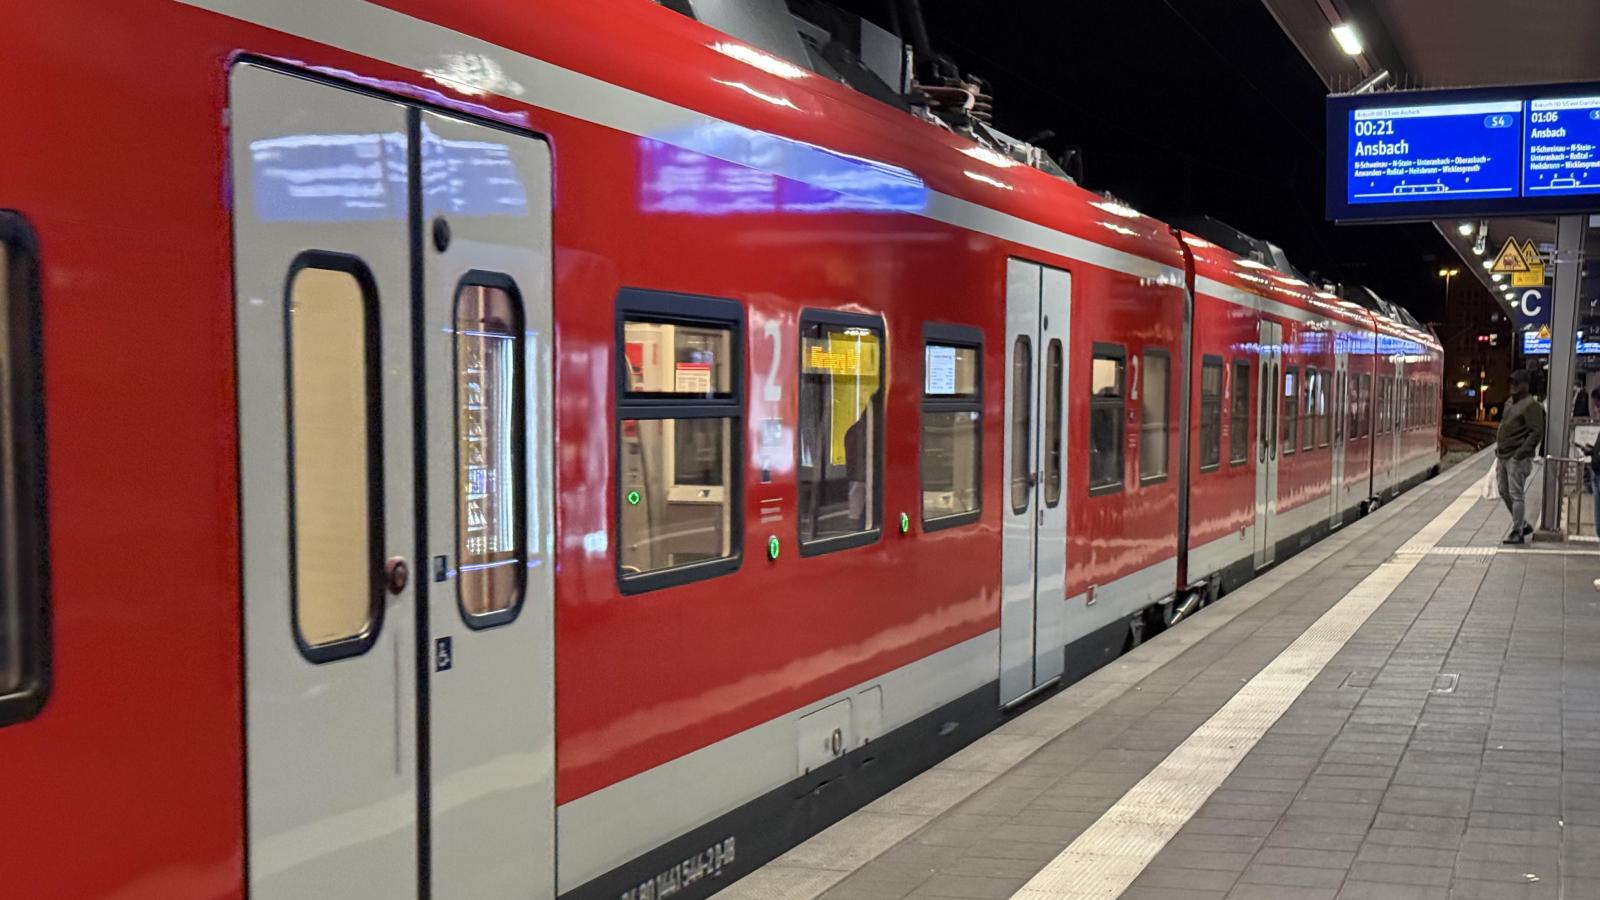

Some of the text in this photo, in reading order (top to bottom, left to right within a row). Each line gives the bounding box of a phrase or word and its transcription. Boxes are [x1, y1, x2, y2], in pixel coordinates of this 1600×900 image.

[1355, 120, 1394, 136] 00:21
[1530, 126, 1566, 139] Ansbach
[1354, 139, 1409, 157] Ansbach
[1521, 289, 1542, 317] C
[764, 319, 782, 401] 2
[1131, 354, 1139, 400] 2
